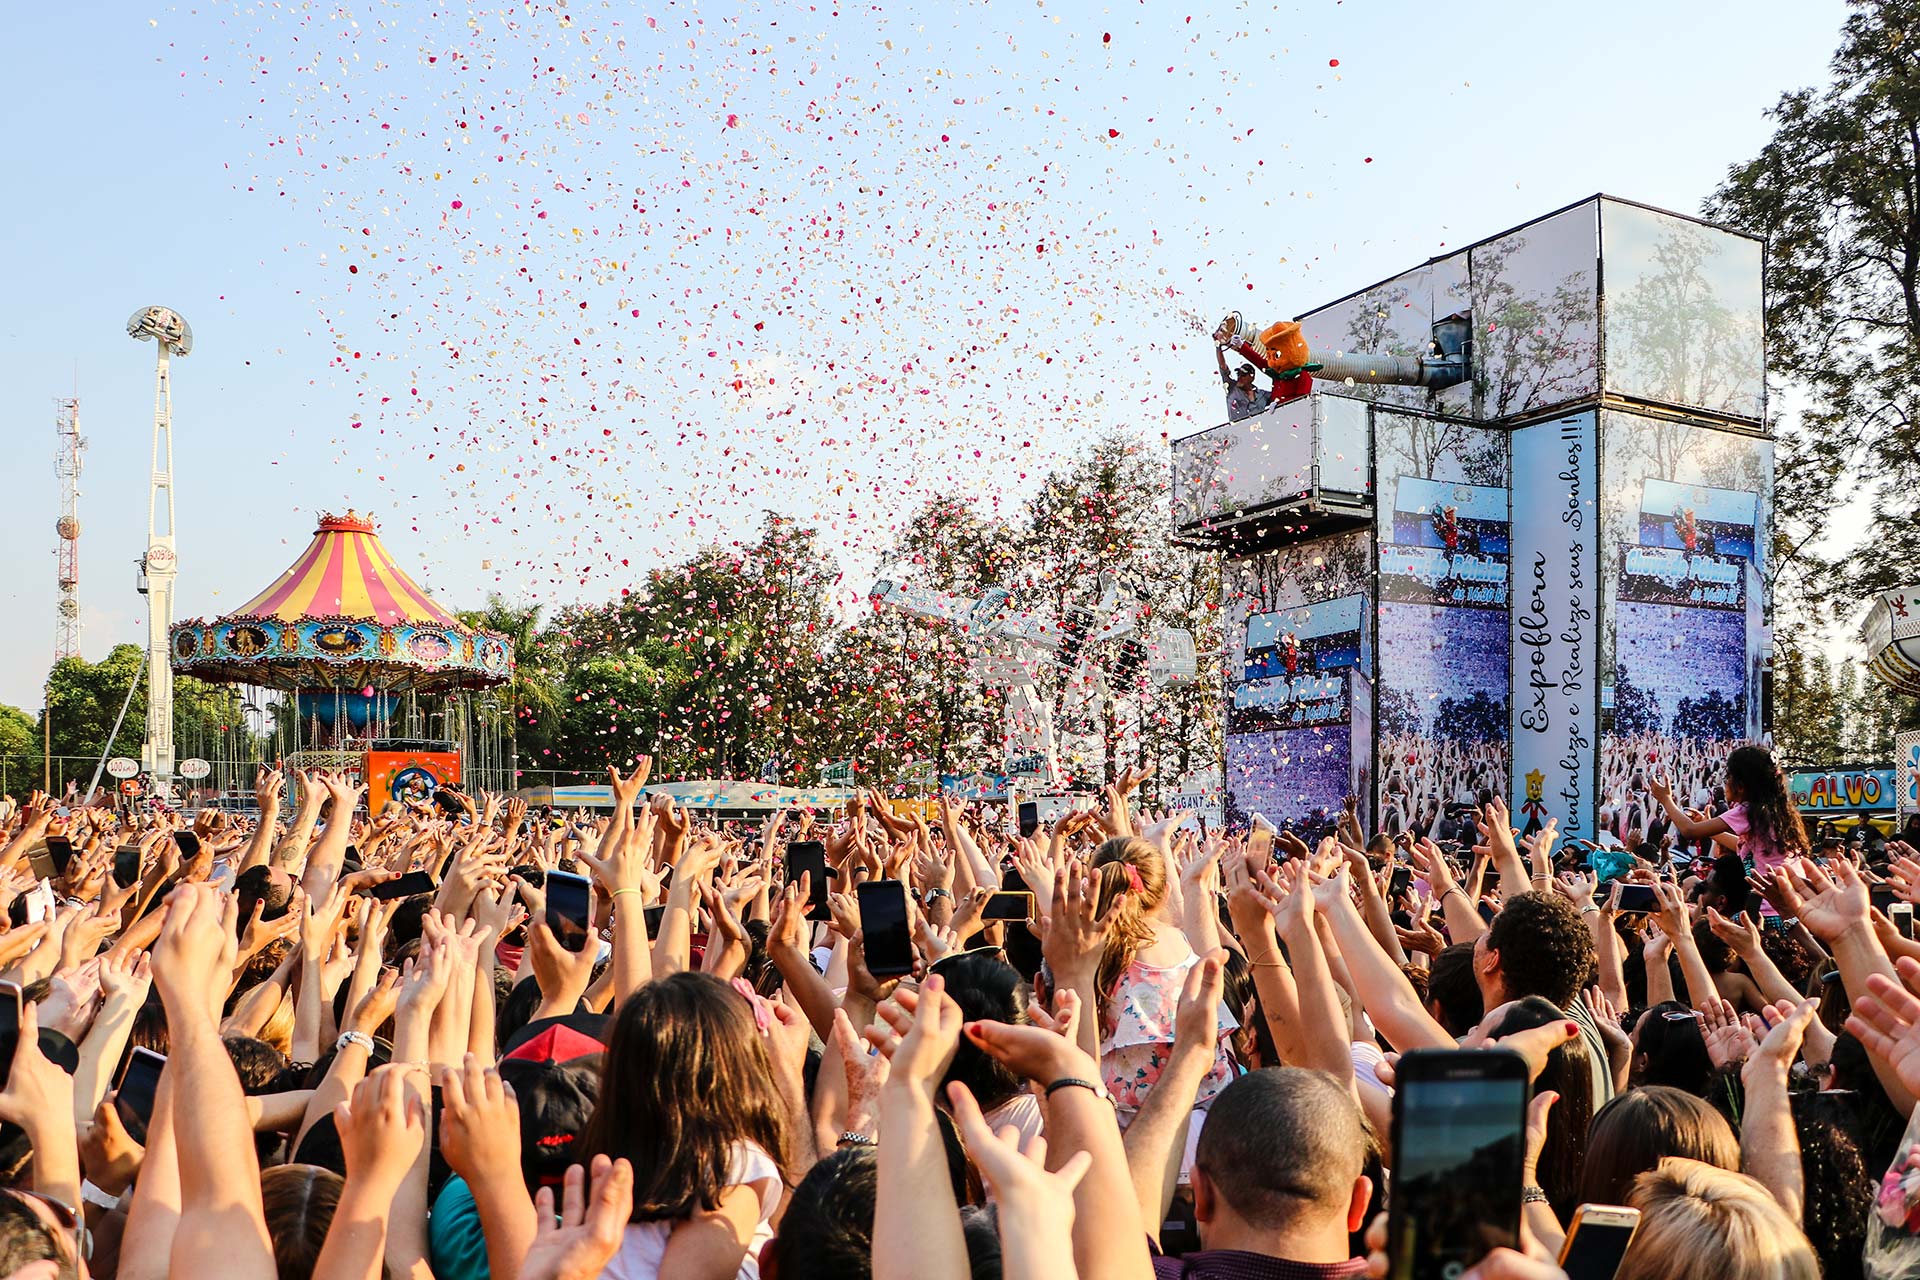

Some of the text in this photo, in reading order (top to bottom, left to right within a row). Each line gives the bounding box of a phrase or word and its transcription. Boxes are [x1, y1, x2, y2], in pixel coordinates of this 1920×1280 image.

[1467, 586, 1496, 602] 16:30
[1519, 551, 1559, 733] Expoflora
[1558, 418, 1591, 847] Mentalize e Realize seus Sonhos!!!
[1809, 776, 1881, 808] ALVO
